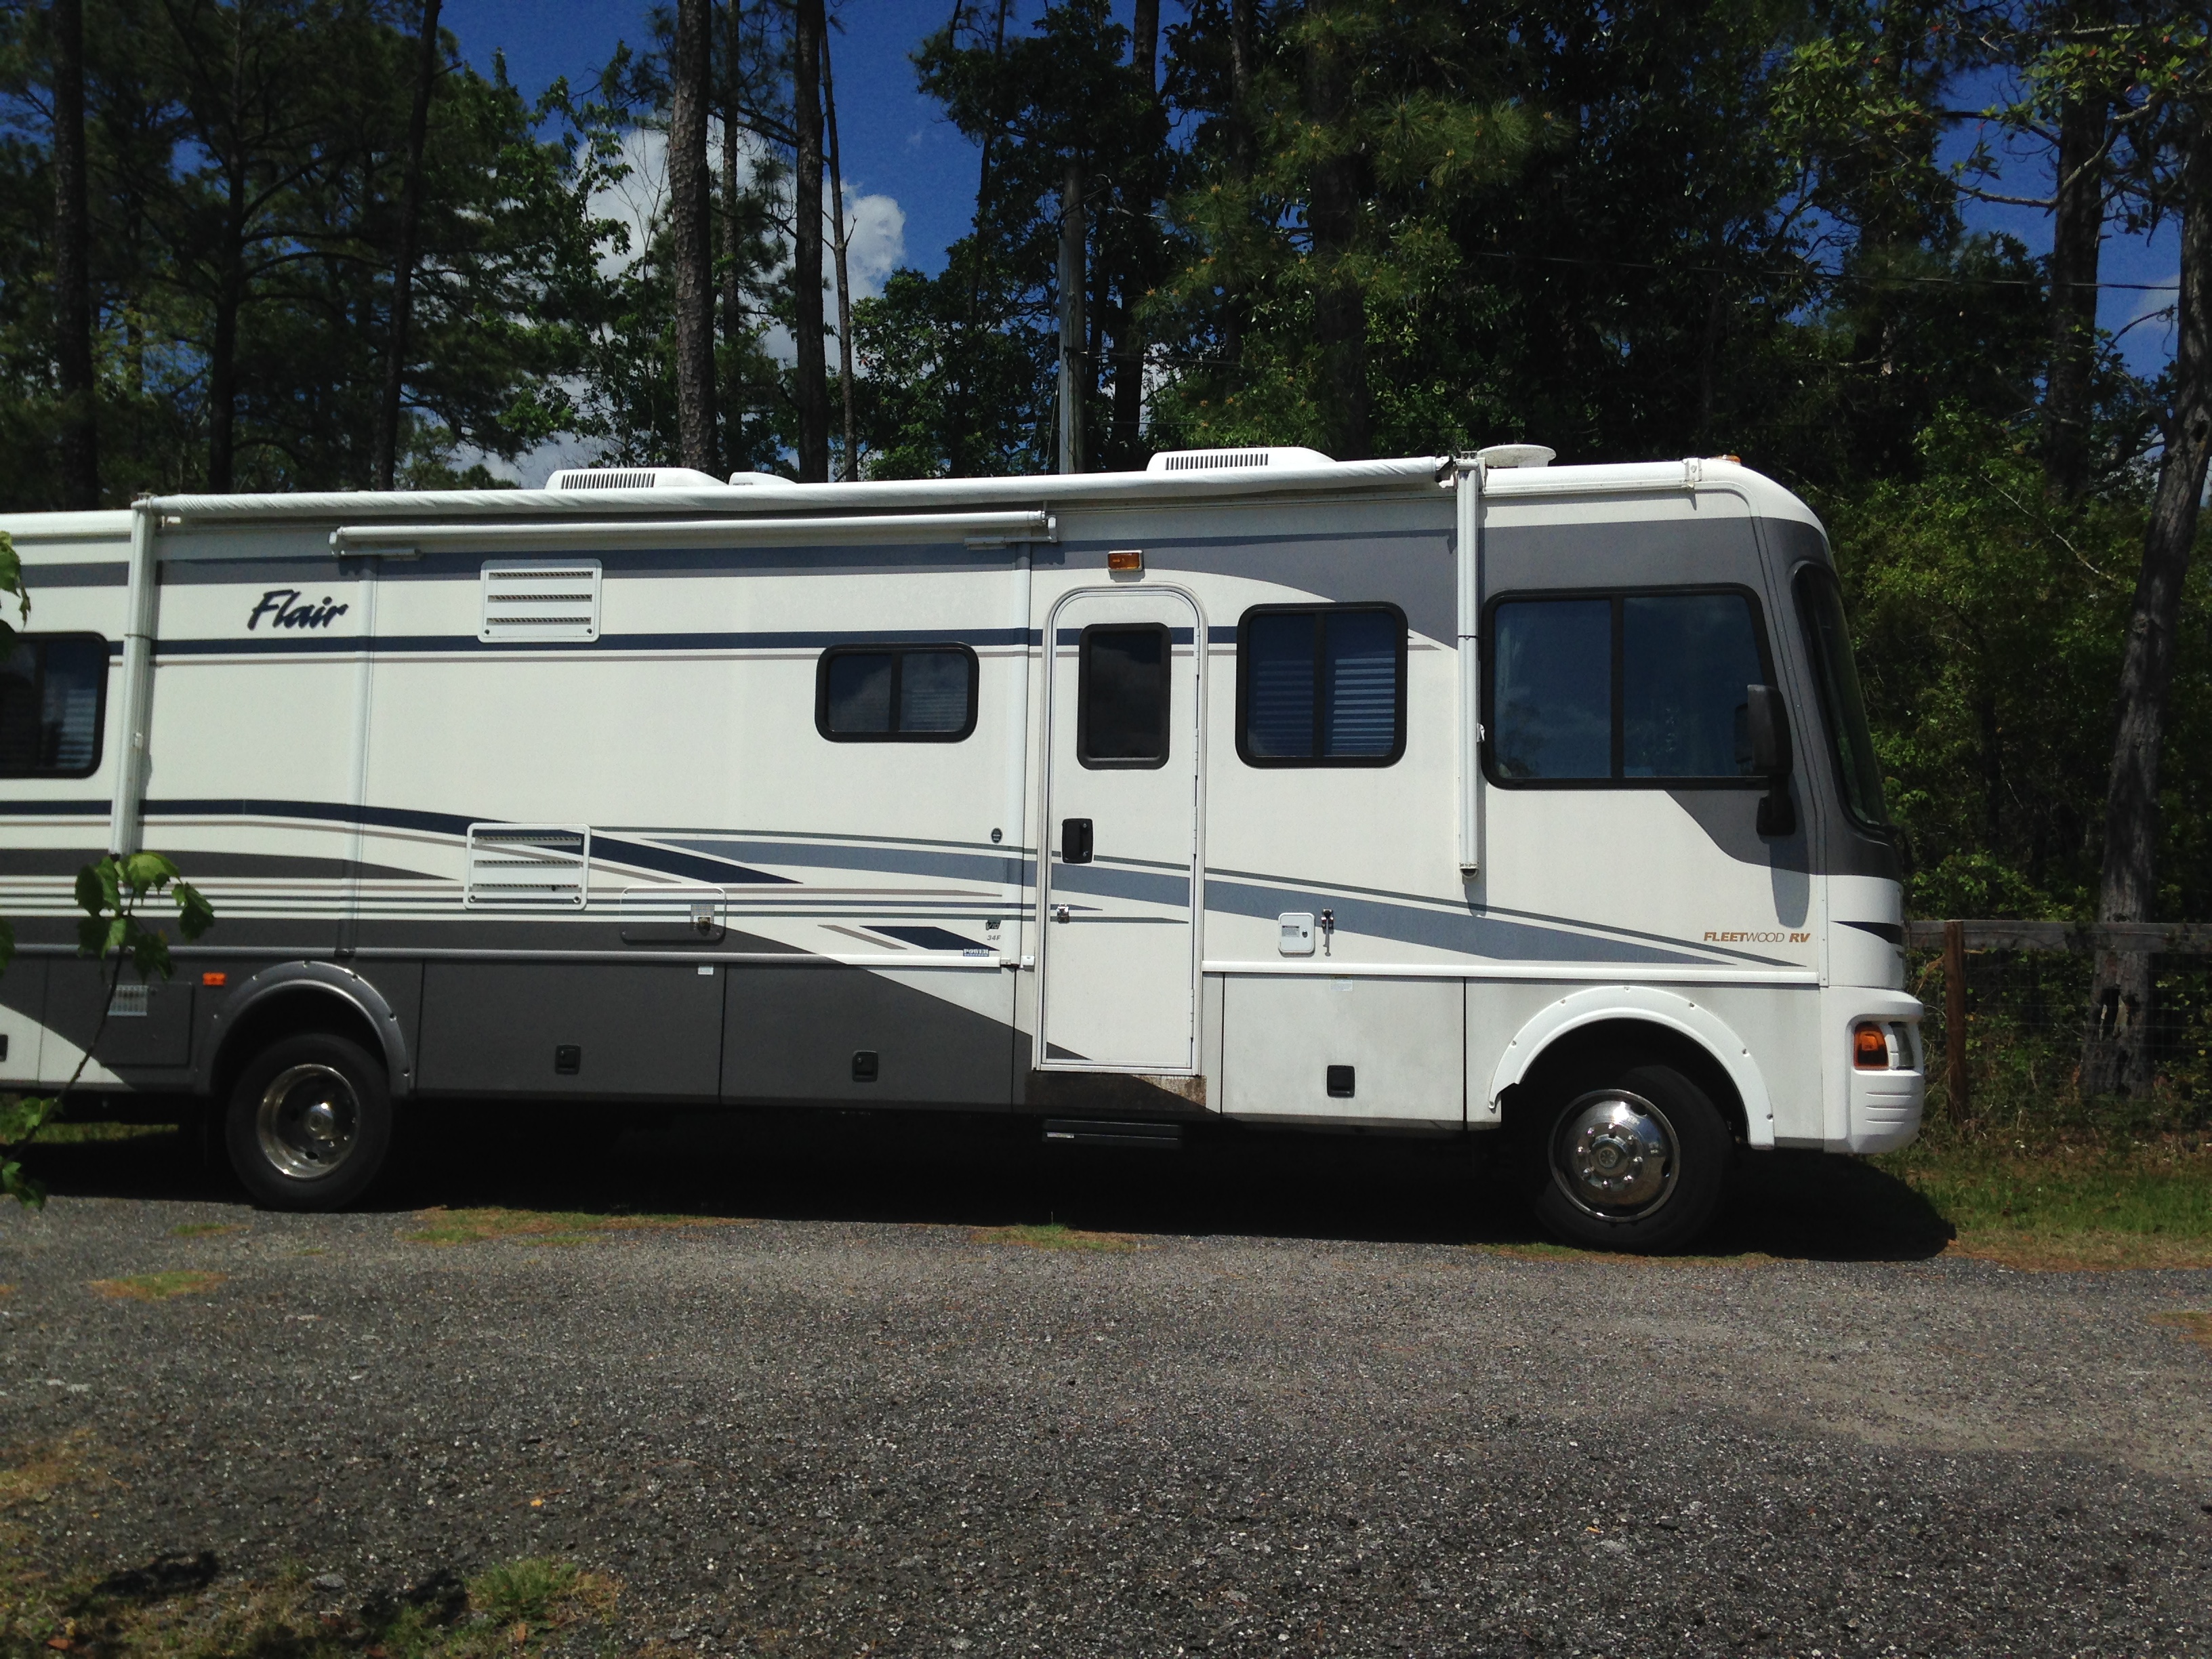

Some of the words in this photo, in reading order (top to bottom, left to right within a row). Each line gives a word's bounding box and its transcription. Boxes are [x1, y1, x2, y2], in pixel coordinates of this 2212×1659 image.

[247, 589, 349, 631] Flair
[1704, 932, 1785, 943] FLEETWOOD
[1788, 933, 1811, 943] RV
